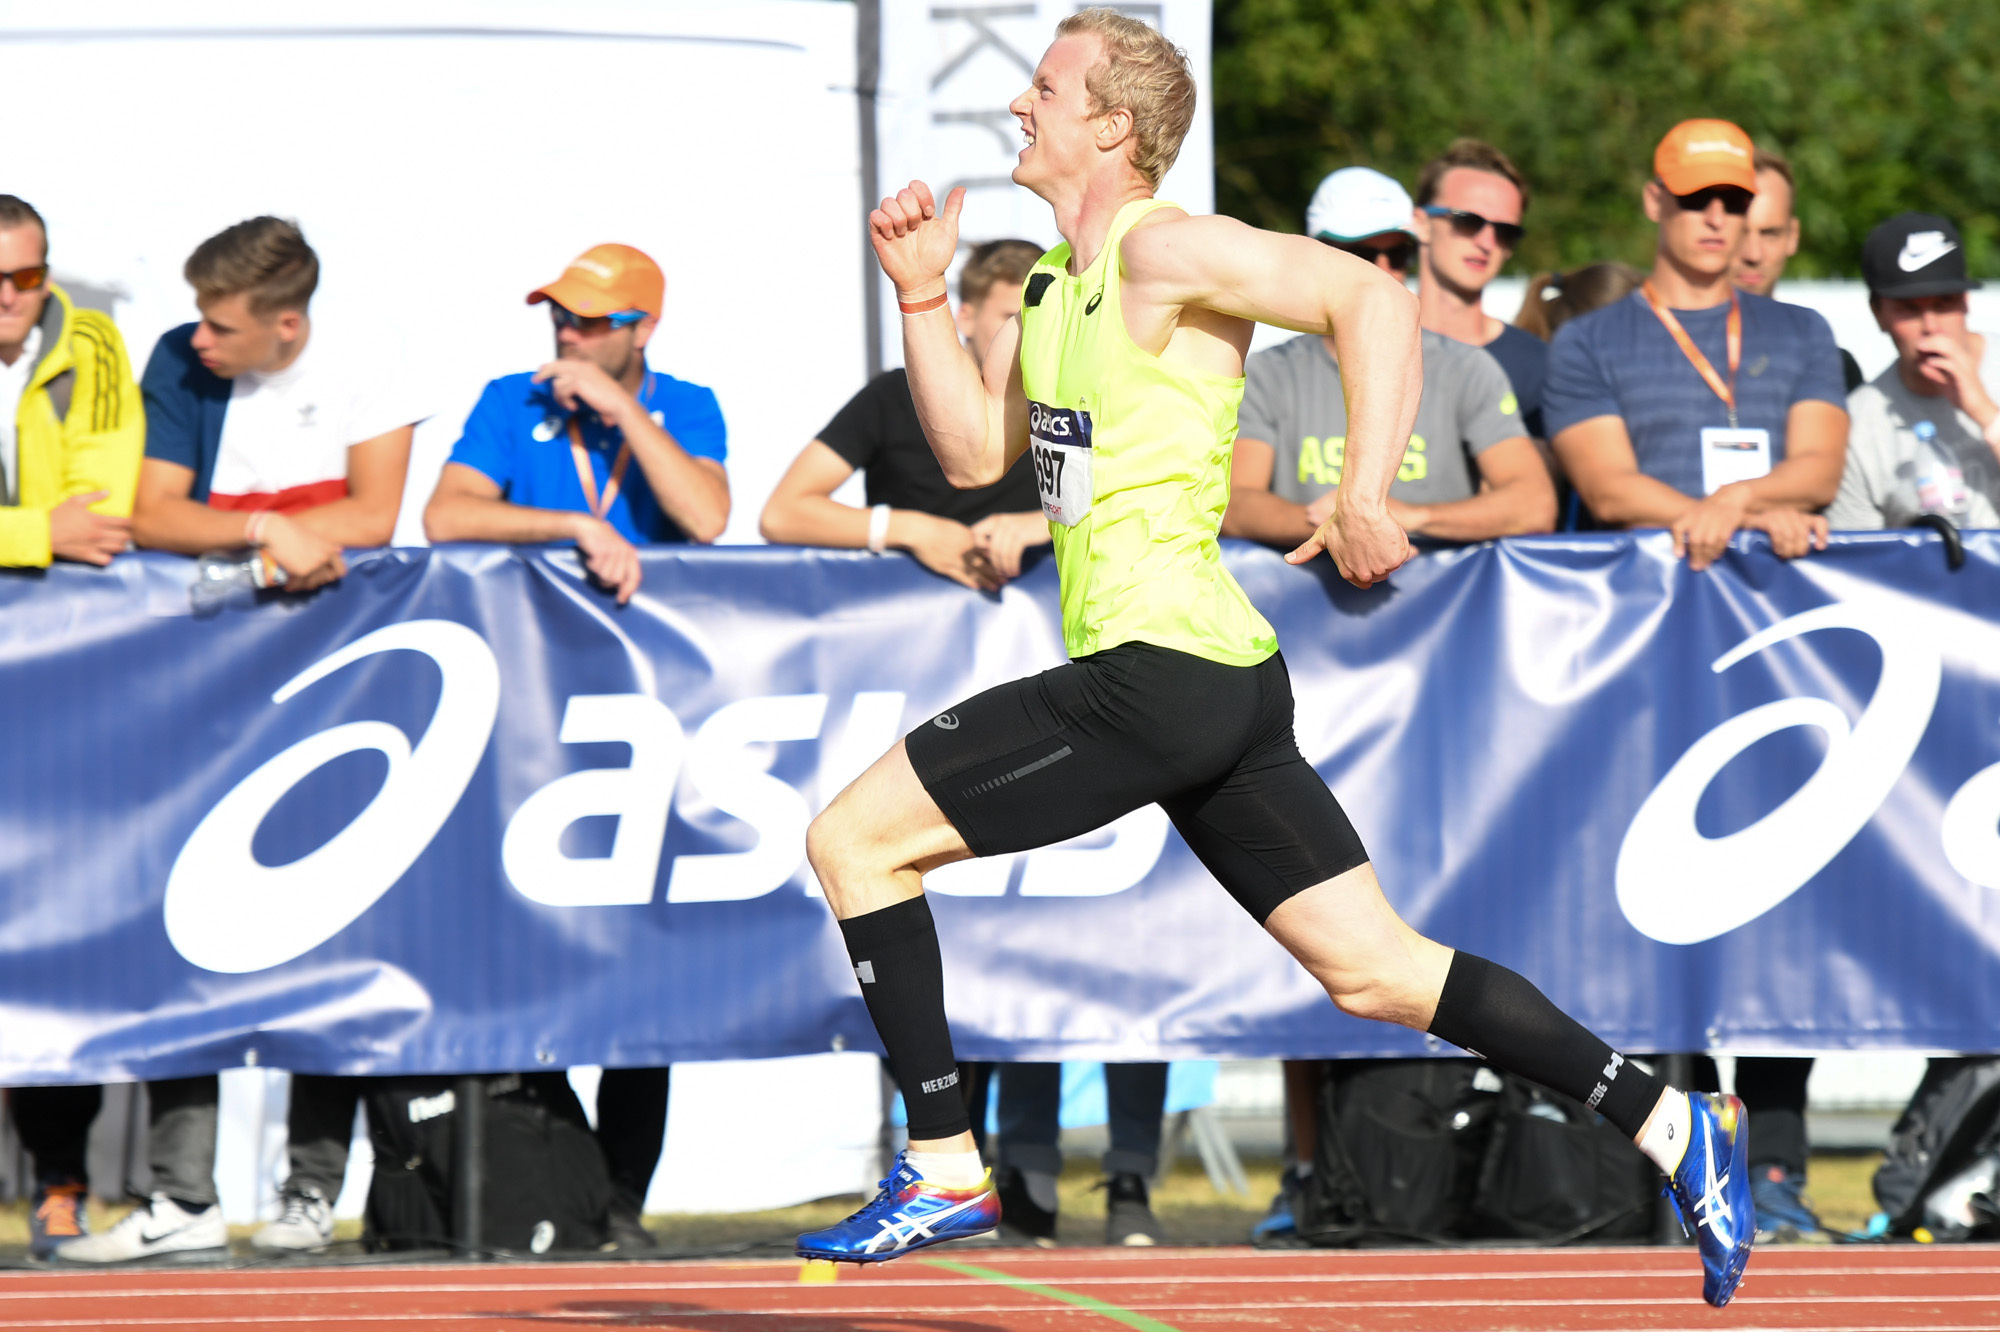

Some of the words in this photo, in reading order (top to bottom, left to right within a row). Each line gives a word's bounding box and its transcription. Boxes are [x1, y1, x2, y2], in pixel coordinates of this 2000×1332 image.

[1034, 444, 1066, 499] 697
[1297, 433, 1427, 485] ASS
[921, 1071, 958, 1094] HERZOG
